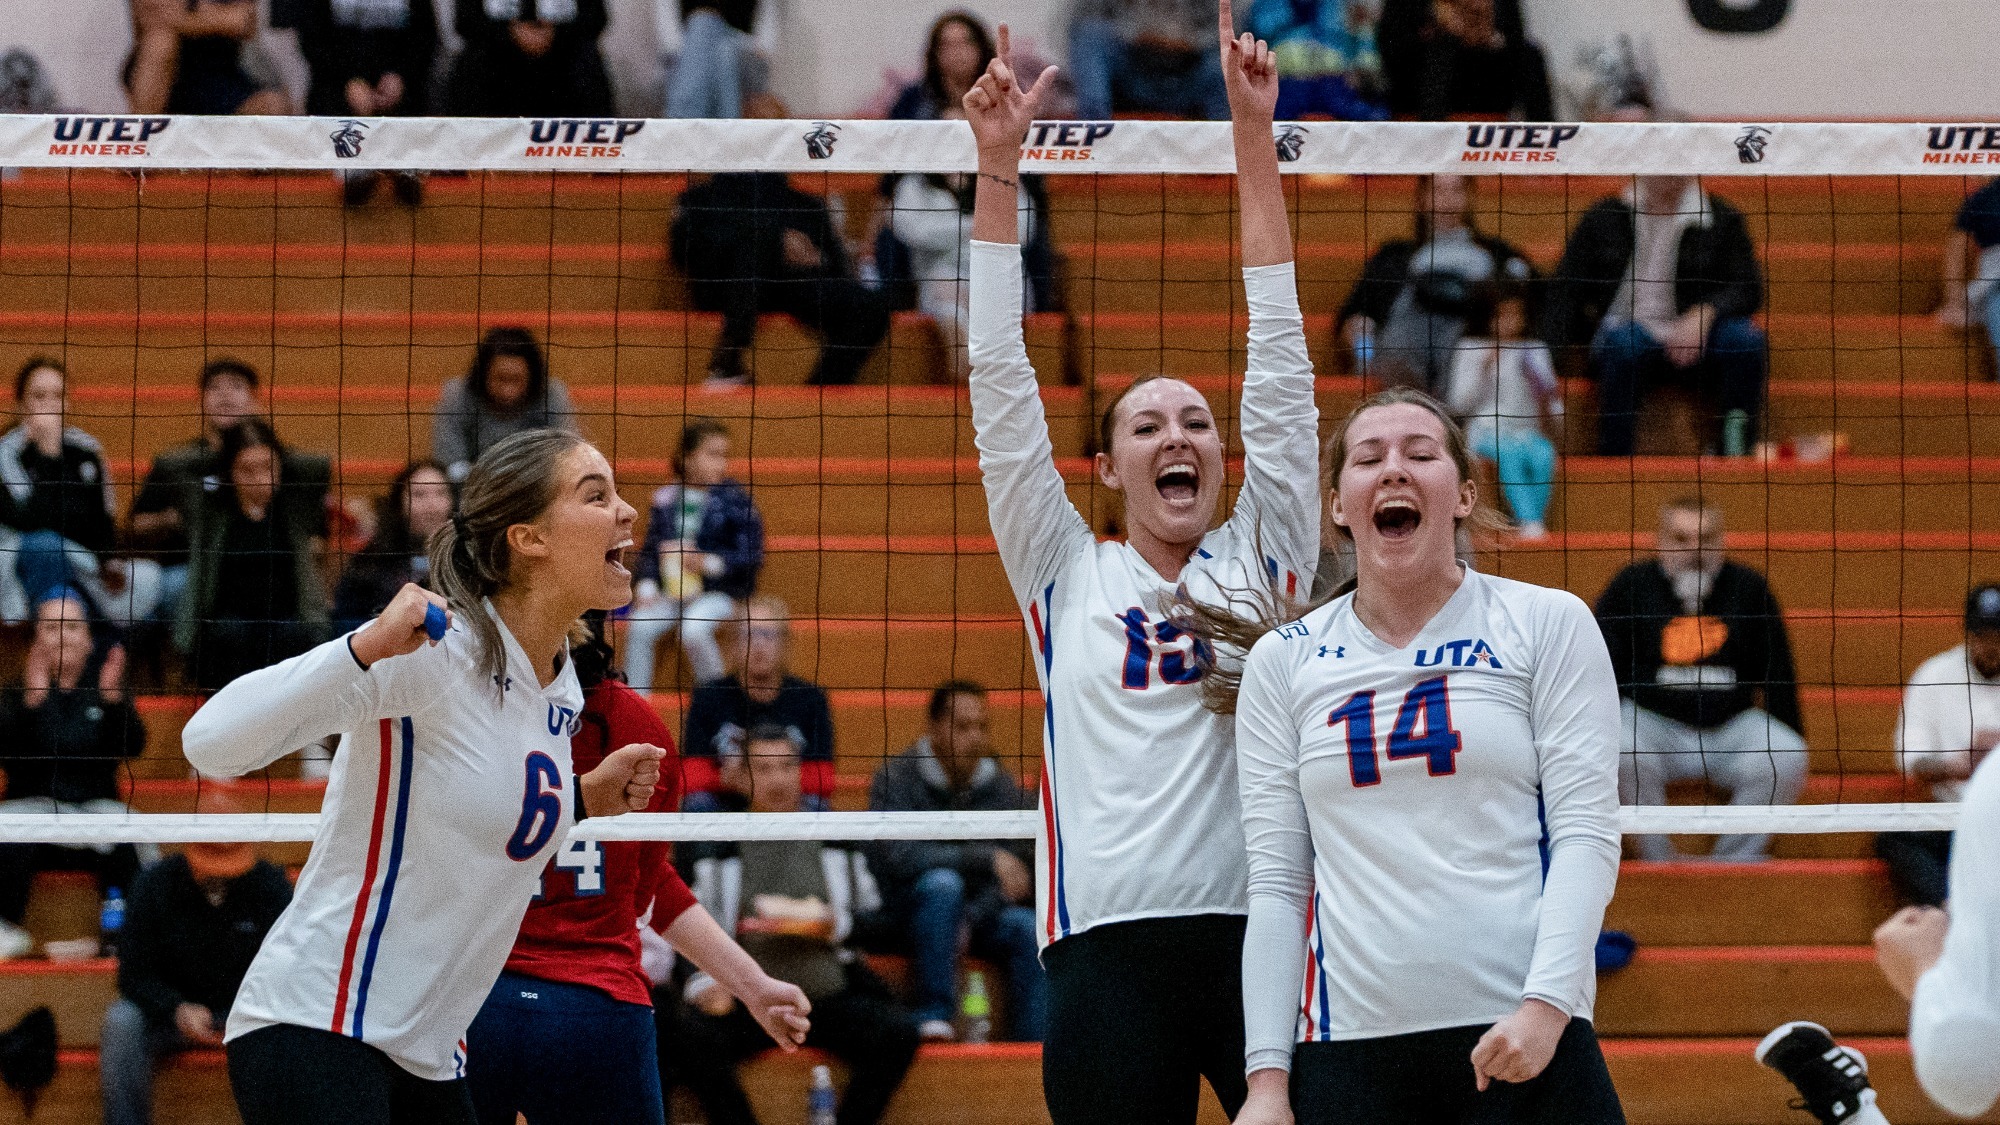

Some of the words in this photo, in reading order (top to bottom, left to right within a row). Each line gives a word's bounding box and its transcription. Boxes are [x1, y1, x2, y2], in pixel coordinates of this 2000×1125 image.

[54, 117, 171, 142] UTEP
[529, 119, 646, 143] UTEP
[1021, 123, 1115, 147] TEP
[1466, 125, 1580, 149] UTEP
[1414, 638, 1504, 670] UTA
[1327, 674, 1463, 788] 14
[505, 750, 563, 862] 6
[520, 991, 539, 1000] DSG
